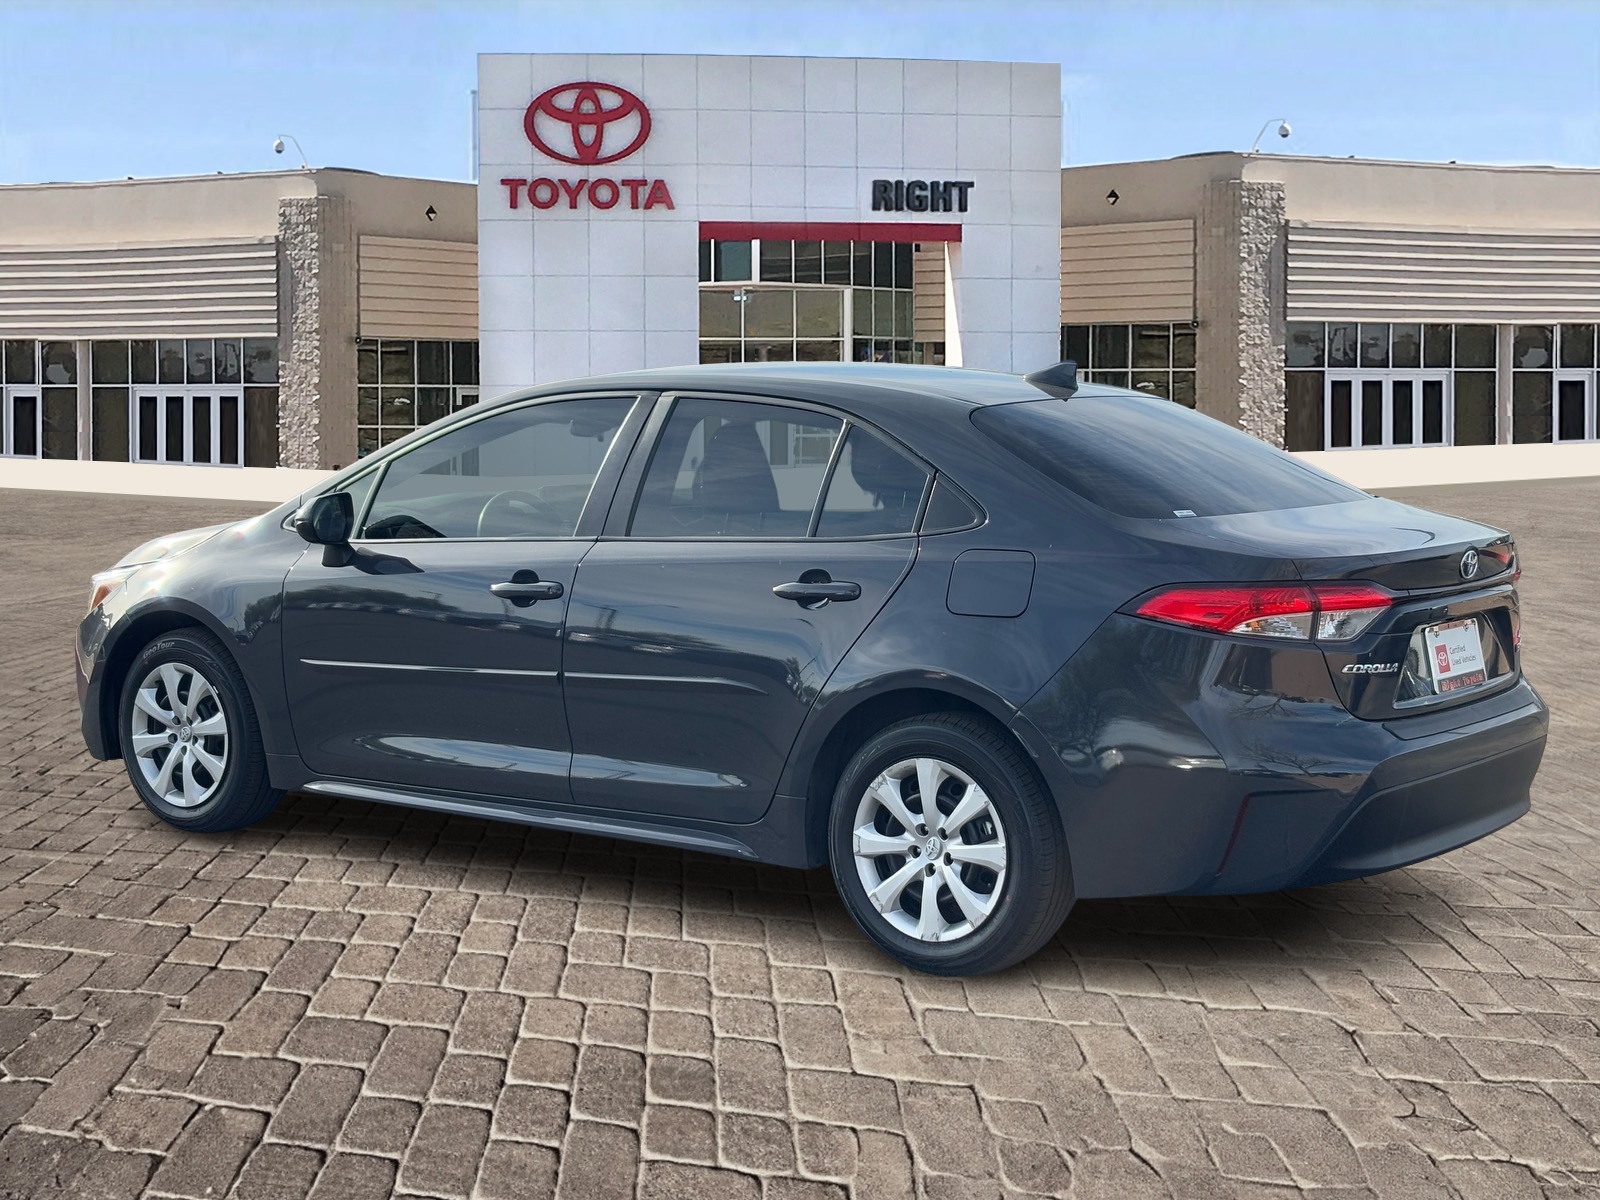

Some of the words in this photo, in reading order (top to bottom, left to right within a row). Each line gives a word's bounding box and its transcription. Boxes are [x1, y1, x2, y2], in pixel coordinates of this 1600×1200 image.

[500, 177, 676, 210] TOYOTA
[871, 179, 975, 212] RIGHT
[1449, 644, 1466, 655] Certified
[1453, 657, 1462, 666] Used
[1462, 655, 1477, 664] Vehicles
[1341, 662, 1399, 674] COROLLA
[1462, 673, 1483, 685] Toyota
